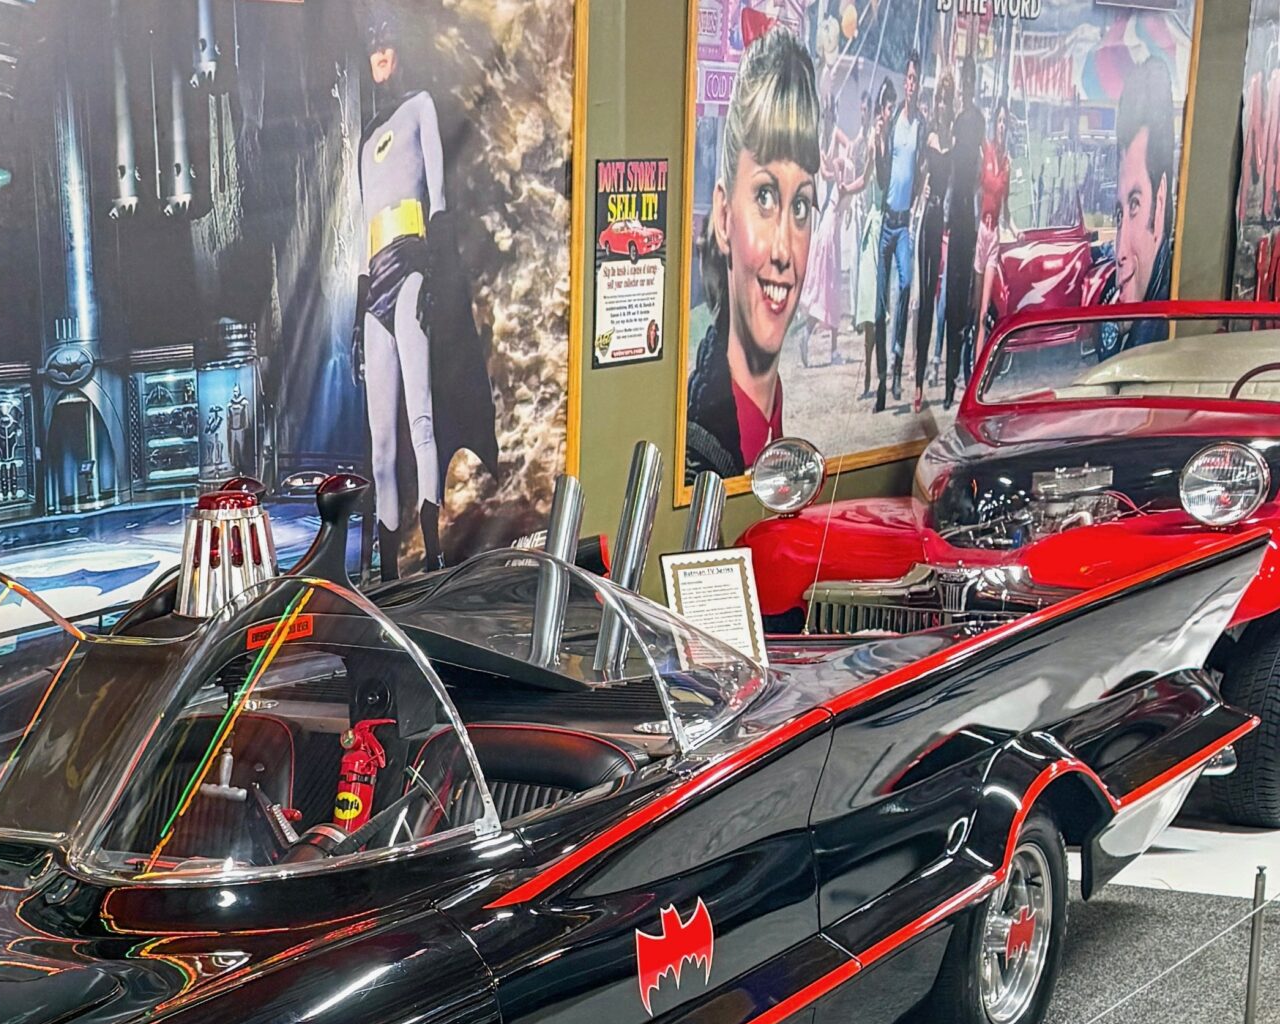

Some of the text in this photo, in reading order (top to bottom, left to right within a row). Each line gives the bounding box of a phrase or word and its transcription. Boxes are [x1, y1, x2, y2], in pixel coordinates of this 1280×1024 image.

[993, 0, 1041, 18] WORD
[627, 161, 657, 191] STORE
[658, 161, 668, 190] IT
[608, 192, 658, 223] SELL IT!
